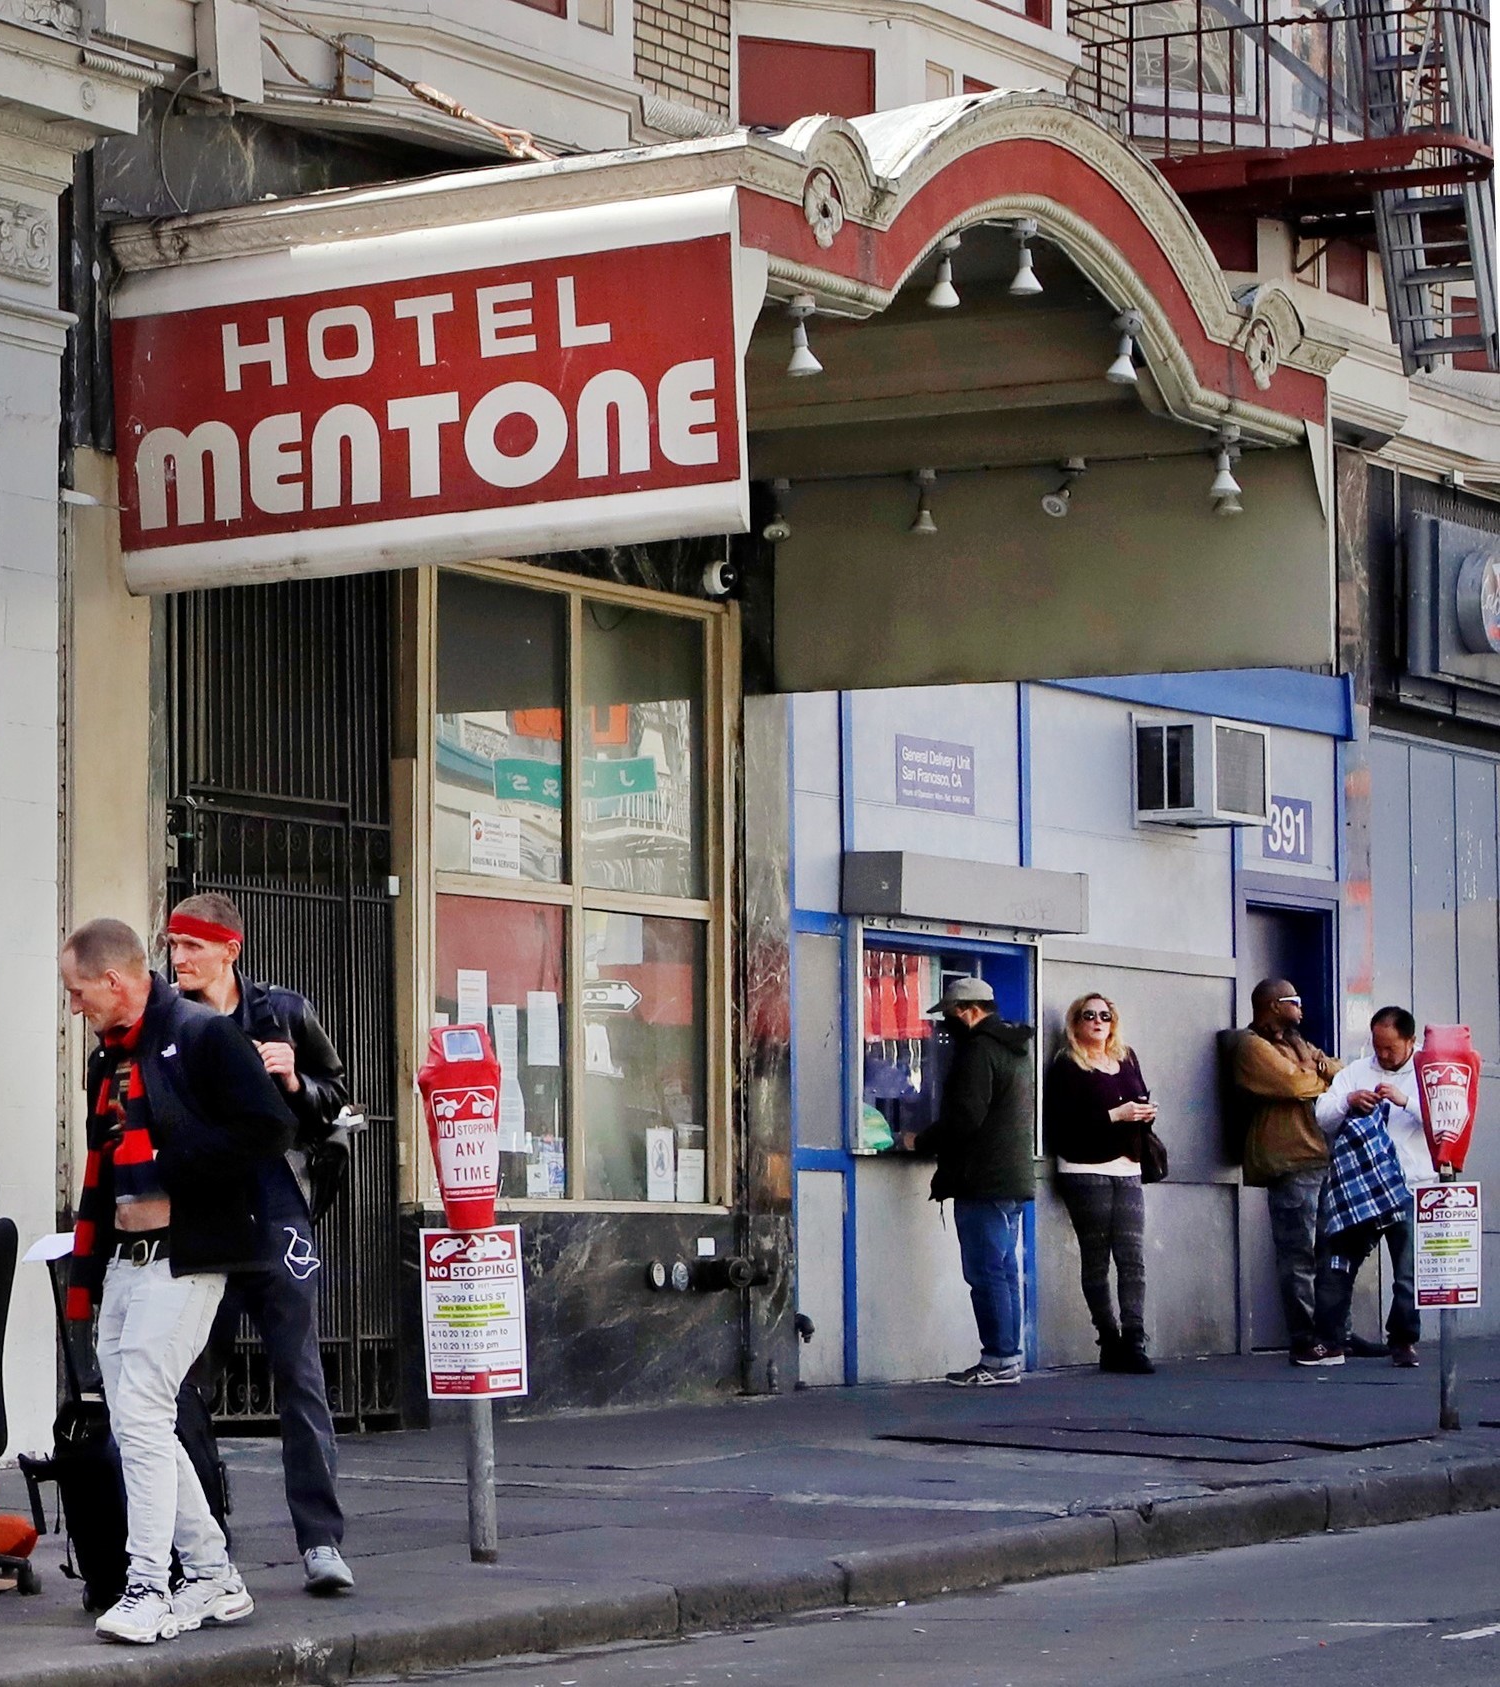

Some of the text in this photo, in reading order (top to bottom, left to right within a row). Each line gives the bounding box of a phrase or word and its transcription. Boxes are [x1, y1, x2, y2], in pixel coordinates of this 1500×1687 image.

[221, 275, 612, 392] HOTEL
[135, 357, 719, 531] MENTONE
[902, 746, 971, 771] General Delivery Unit
[902, 765, 962, 788] San Francisco, CA
[1267, 804, 1305, 856] 391
[1438, 1101, 1460, 1112] ANY
[456, 1141, 485, 1157] ANY
[453, 1165, 491, 1182] TIME
[1419, 1210, 1477, 1221] NO STOPPING
[429, 1263, 515, 1278] NO STOPPING
[460, 1282, 475, 1290] 100
[436, 1291, 507, 1303] 300-399 ELLIS ST
[461, 1329, 483, 1338] 12:01
[462, 1341, 485, 1350] 11:59
[486, 1341, 500, 1350] pm
